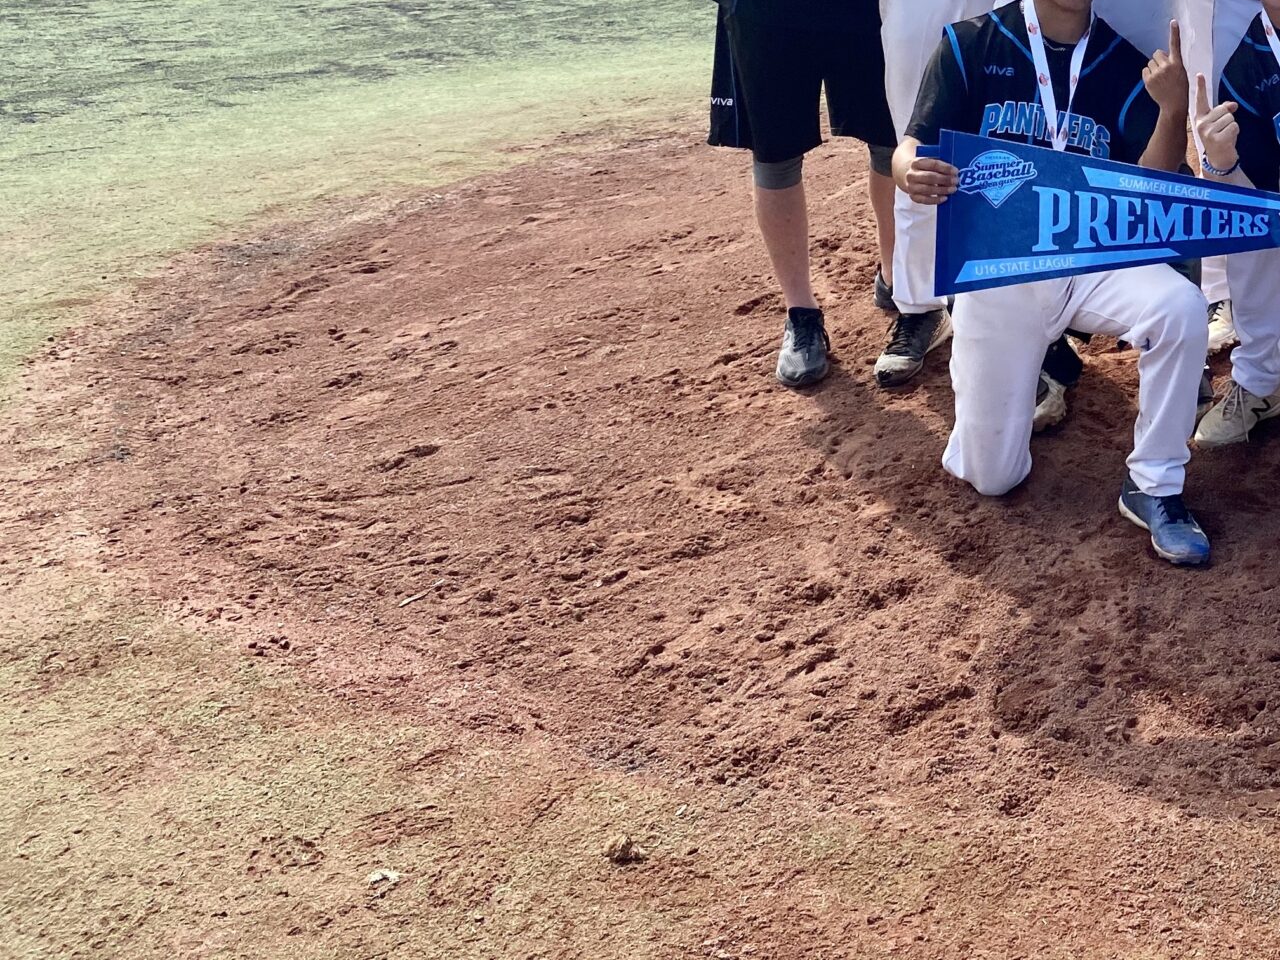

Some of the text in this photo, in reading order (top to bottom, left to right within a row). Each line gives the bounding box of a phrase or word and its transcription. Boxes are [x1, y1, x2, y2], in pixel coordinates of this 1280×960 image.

[960, 162, 1034, 186] Baseball
[973, 159, 1022, 172] Summer
[1118, 176, 1211, 201] SUMMER LEAGUE
[1031, 185, 1270, 252] PREMIERS
[974, 256, 1075, 276] U16 STATE LEAGUE
